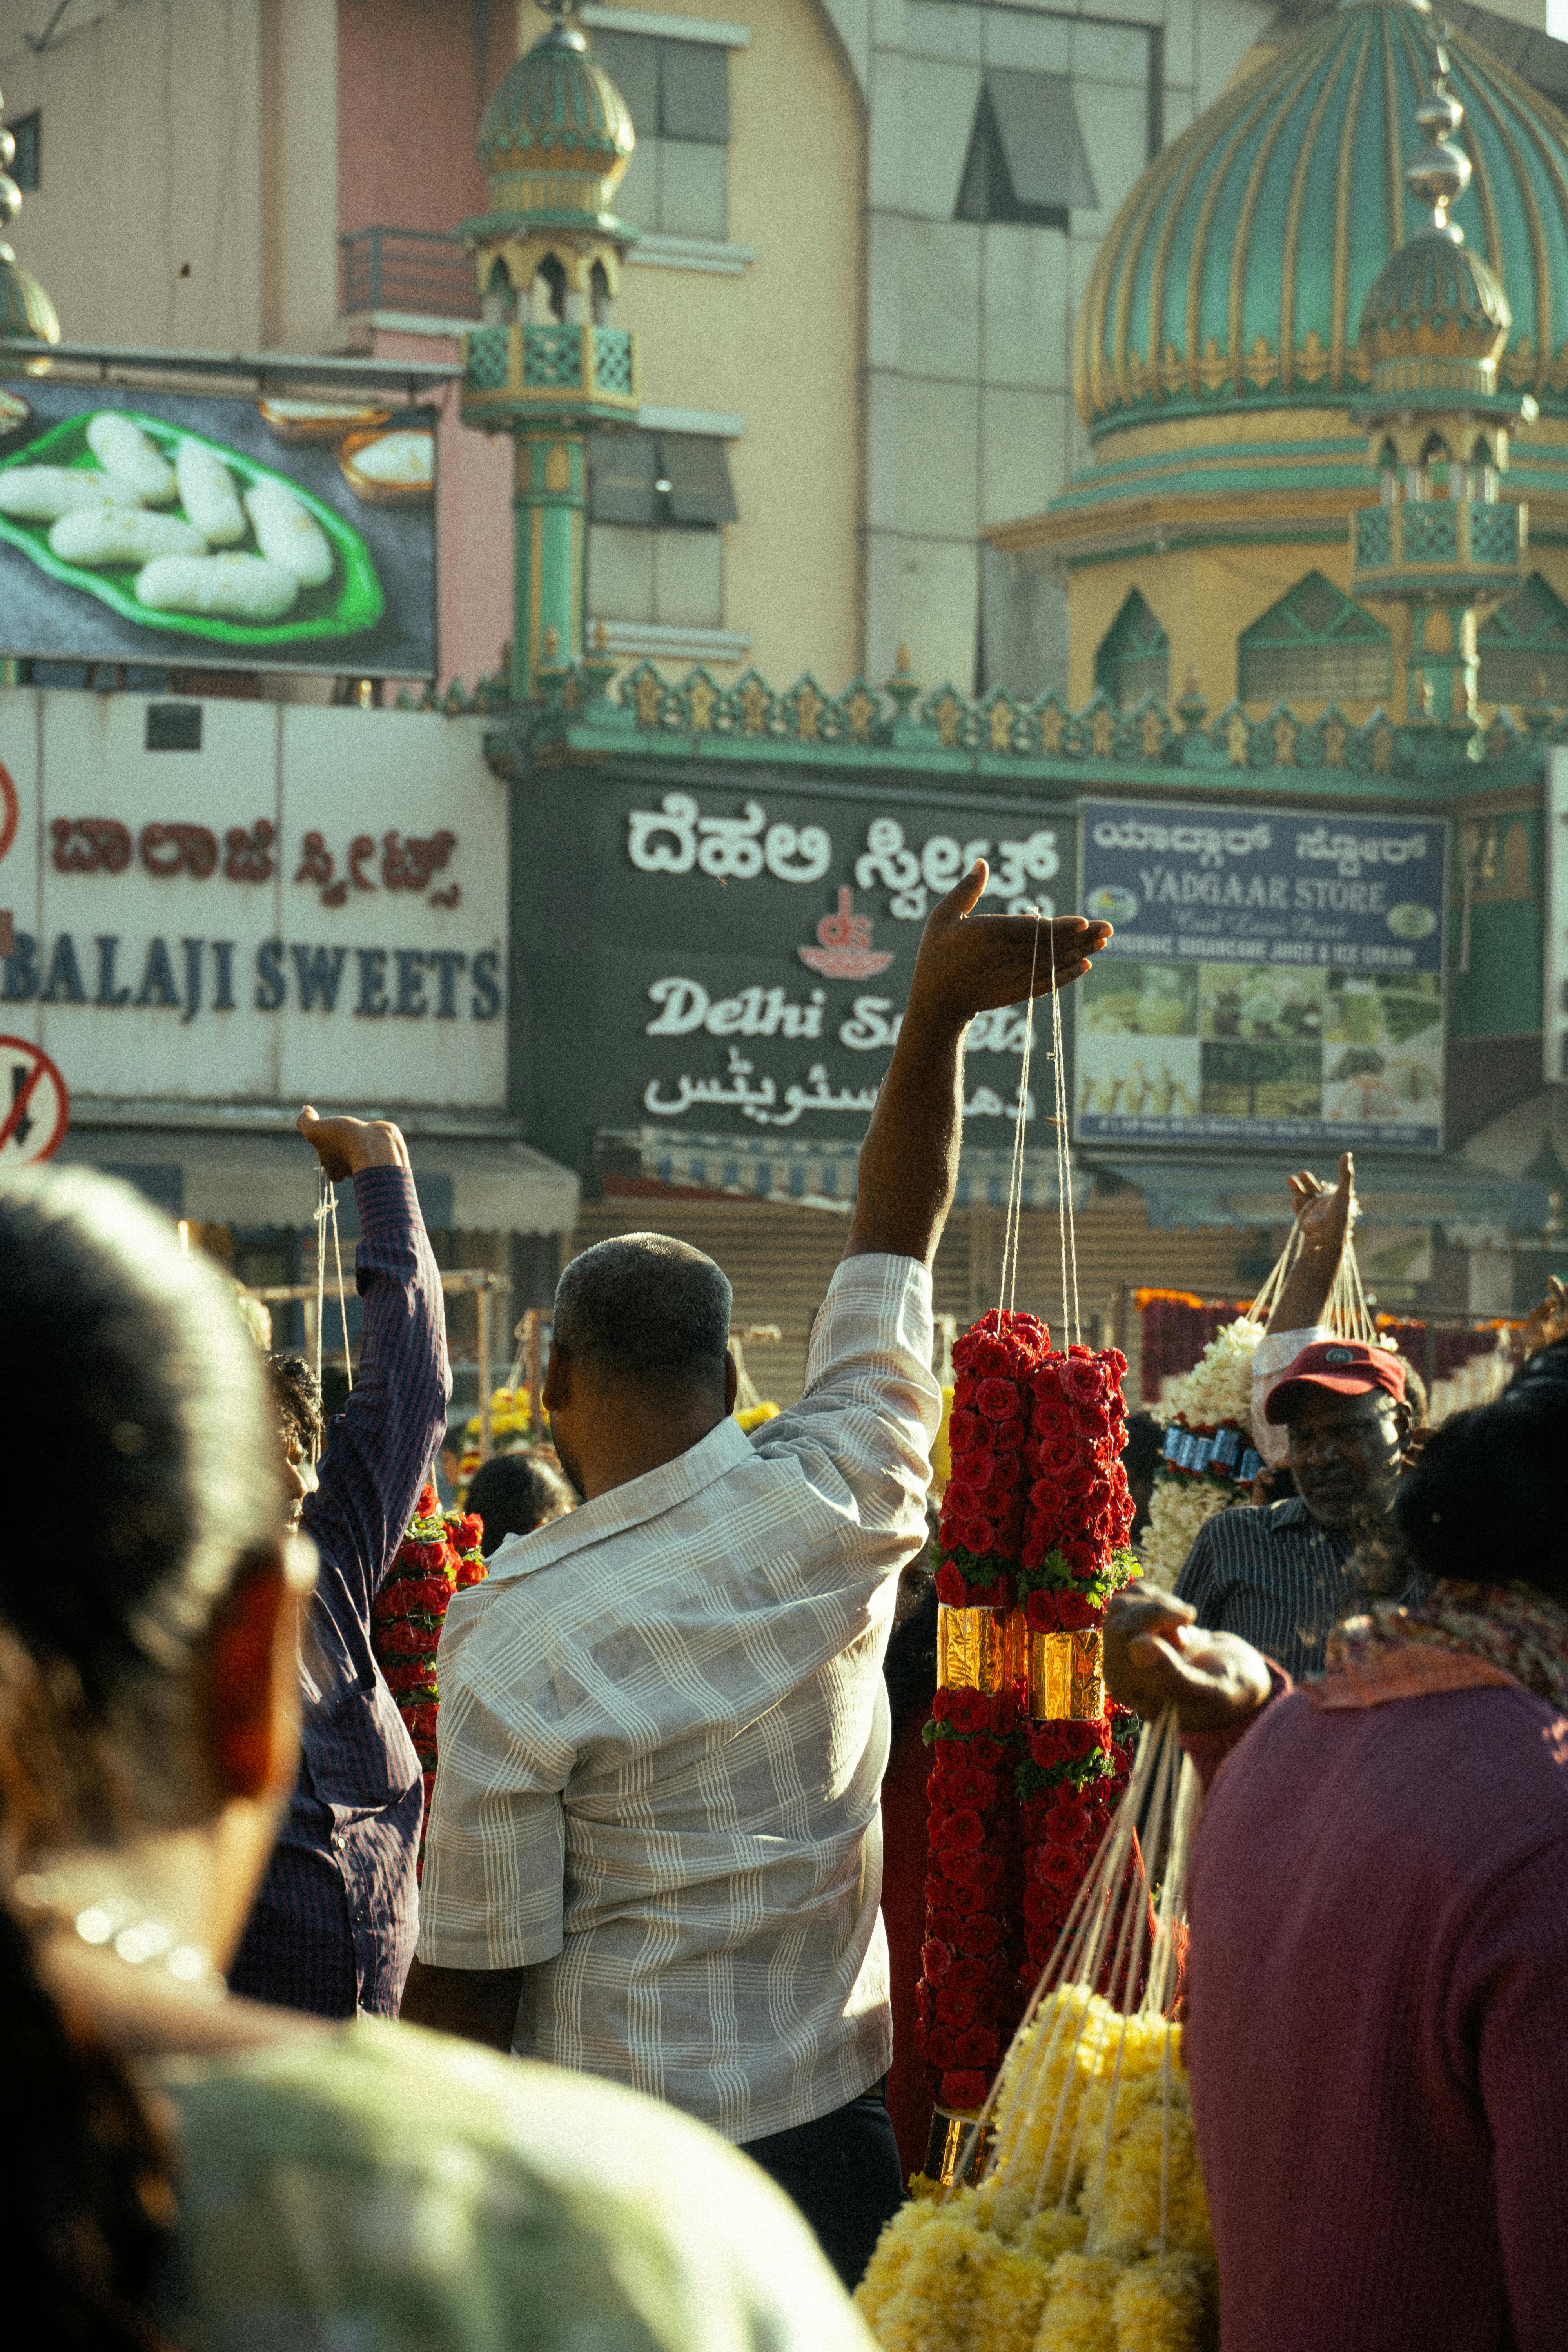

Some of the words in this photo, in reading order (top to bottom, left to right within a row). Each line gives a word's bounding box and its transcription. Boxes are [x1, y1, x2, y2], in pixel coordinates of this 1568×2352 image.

[1138, 866, 1289, 910] YADGAAR
[1295, 878, 1388, 914] STORE
[0, 932, 236, 1024] BALAJI
[255, 937, 502, 1022] SWEETS
[646, 977, 827, 1039] Delhi
[839, 996, 1038, 1054] Sets
